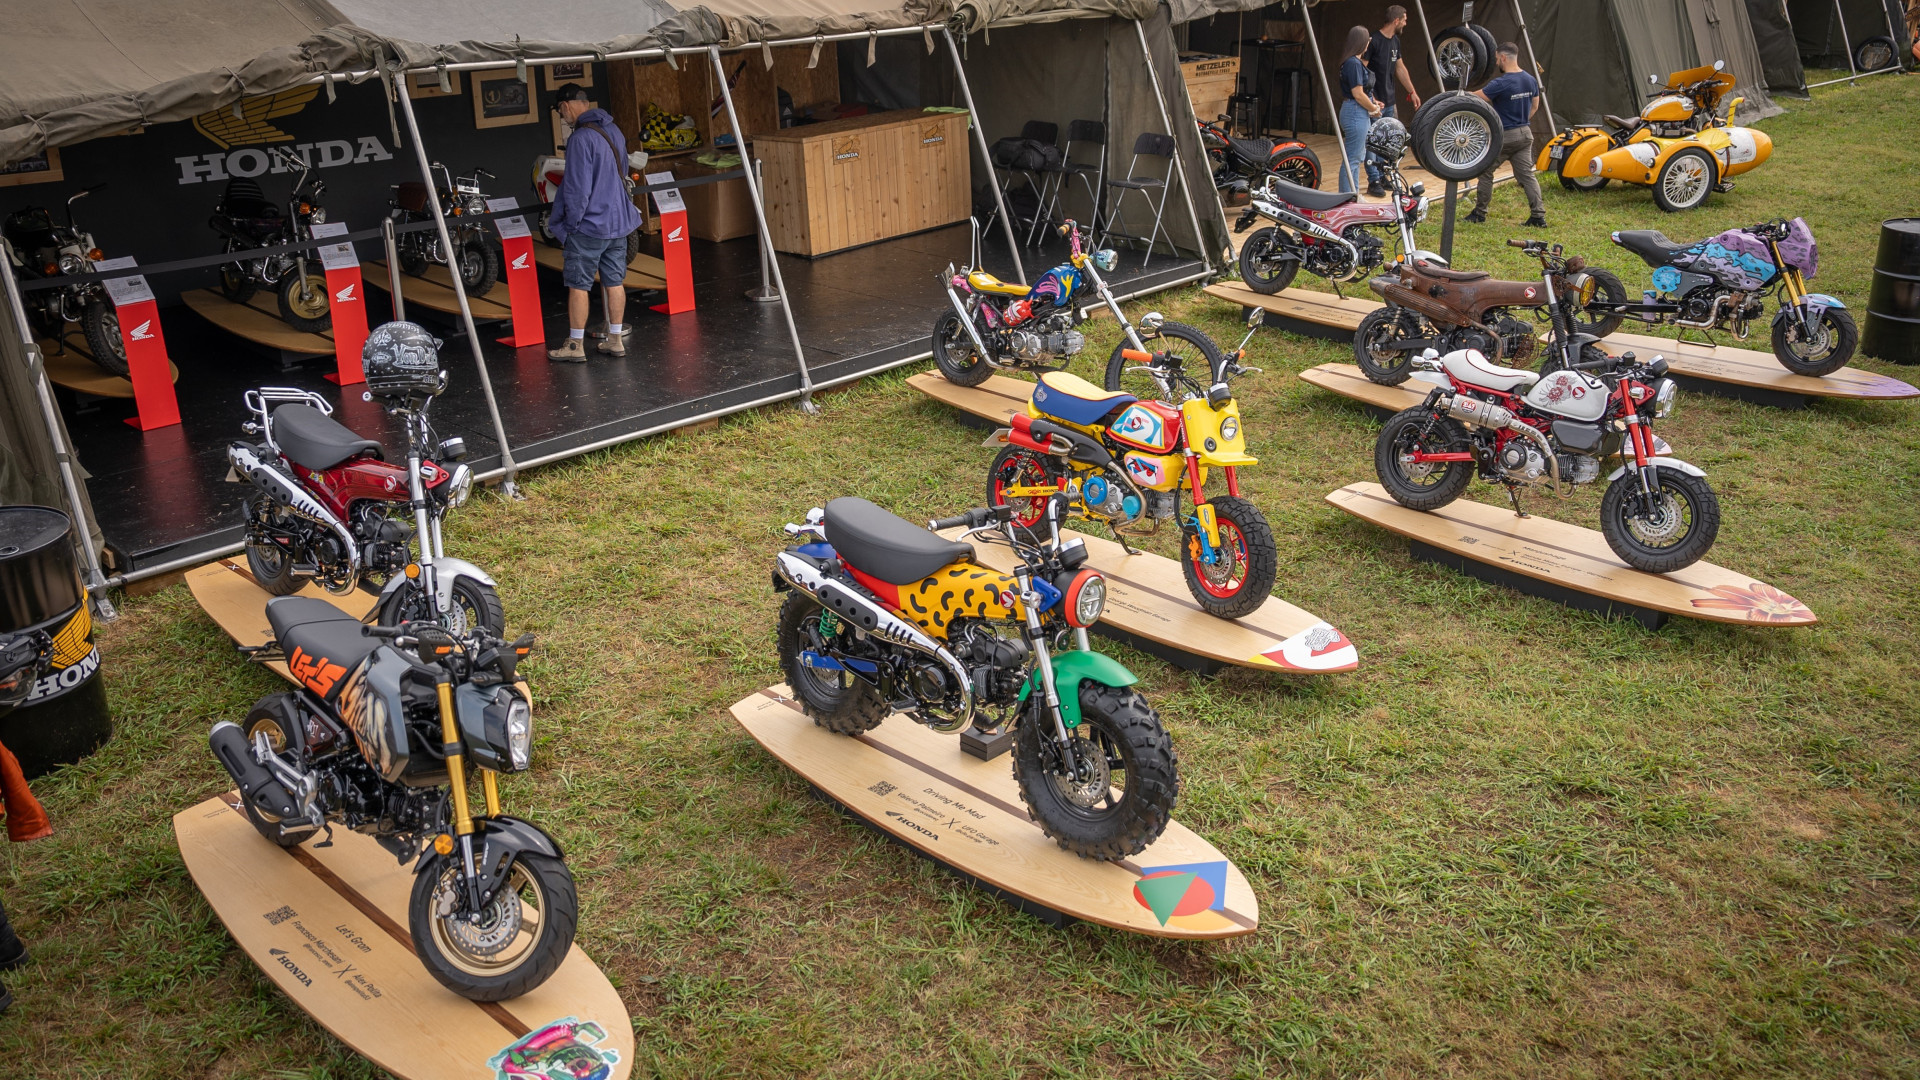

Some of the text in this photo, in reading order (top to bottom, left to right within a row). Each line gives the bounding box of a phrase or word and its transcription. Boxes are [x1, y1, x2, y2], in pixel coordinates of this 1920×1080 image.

[1196, 61, 1231, 71] METZELER
[923, 136, 943, 144] HONDA
[175, 136, 393, 184] HONDA
[837, 151, 859, 160] HONDA
[131, 333, 155, 341] HONDA
[1511, 559, 1551, 573] HONDA
[27, 645, 100, 701] HON
[923, 787, 987, 820] Driving Me Mad
[896, 815, 939, 841] HONDA
[962, 825, 978, 834] UFO
[976, 832, 1000, 846] Garage
[292, 920, 317, 942] Francesco
[336, 924, 372, 953] Let's Grom
[277, 955, 313, 987] HONDA
